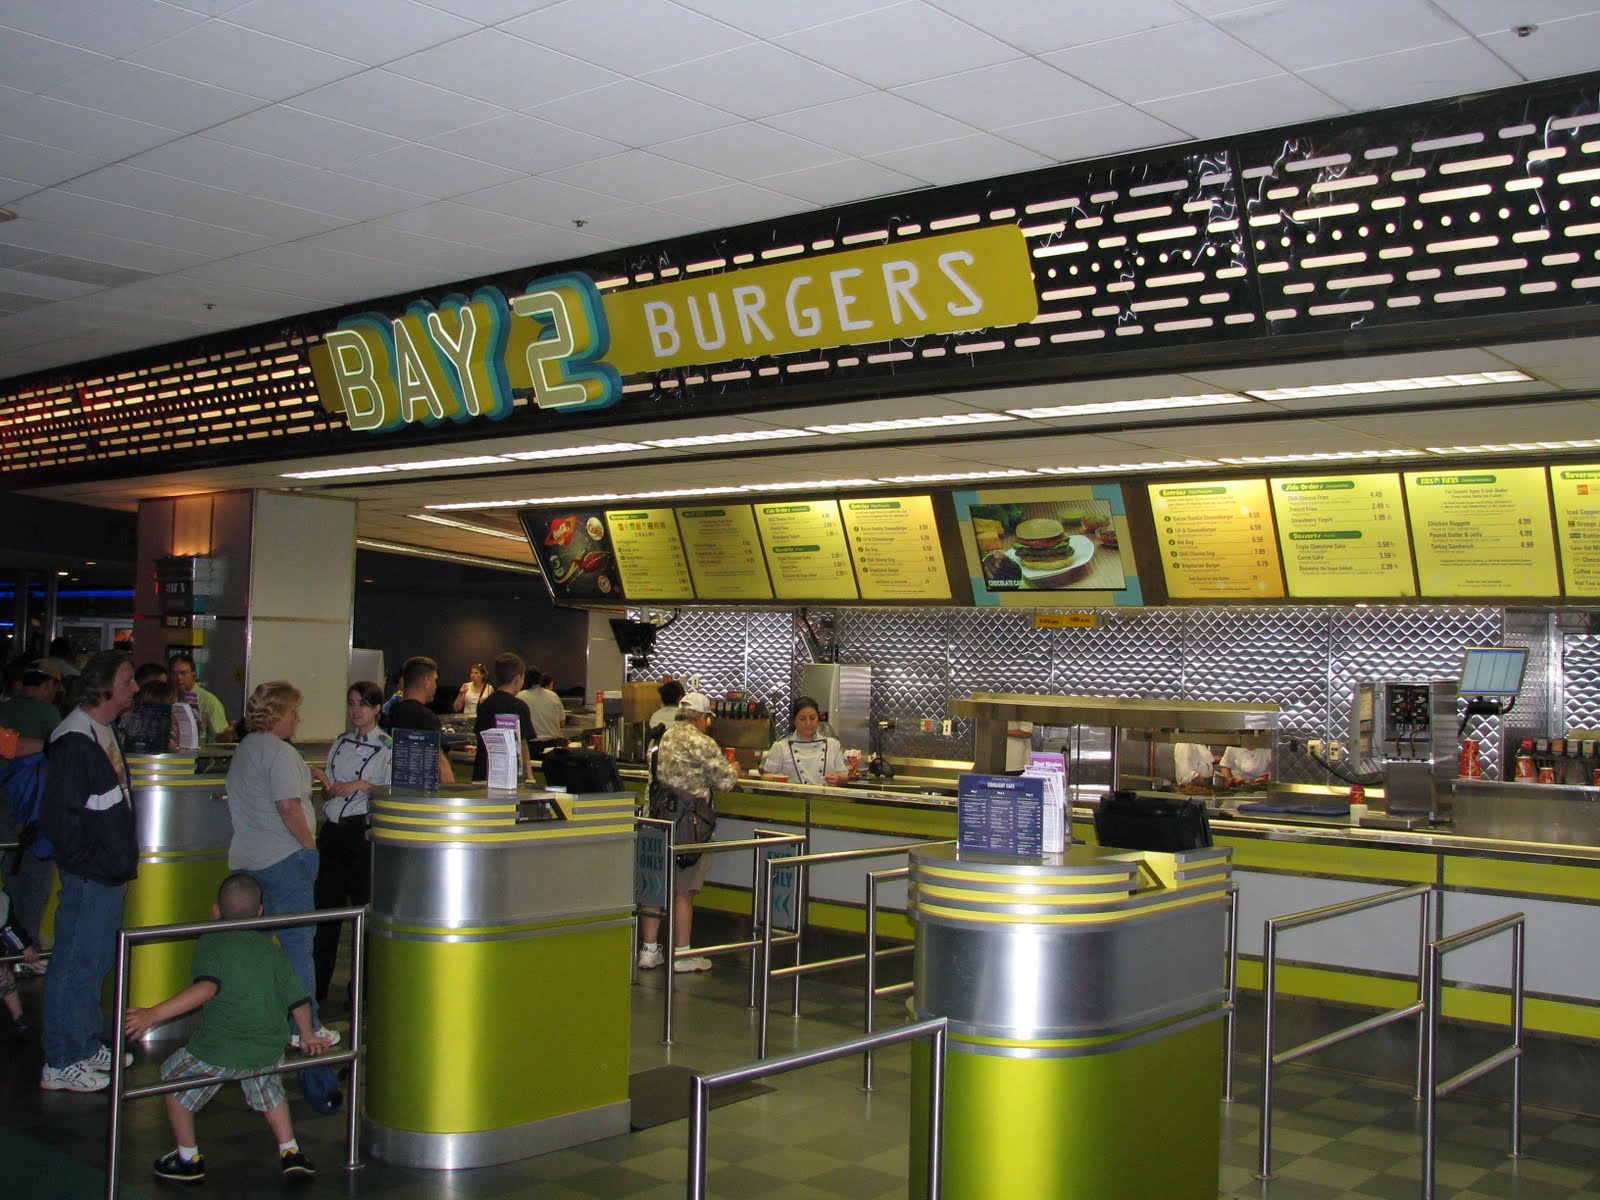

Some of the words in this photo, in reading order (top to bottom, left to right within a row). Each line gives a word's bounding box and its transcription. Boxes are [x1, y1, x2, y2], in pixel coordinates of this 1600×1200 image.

[326, 306, 485, 430] BAY
[514, 291, 587, 408] 2
[643, 250, 983, 358] BURGERS
[641, 836, 663, 853] EXIT
[640, 853, 664, 871] ONLY
[774, 870, 793, 888] NLY
